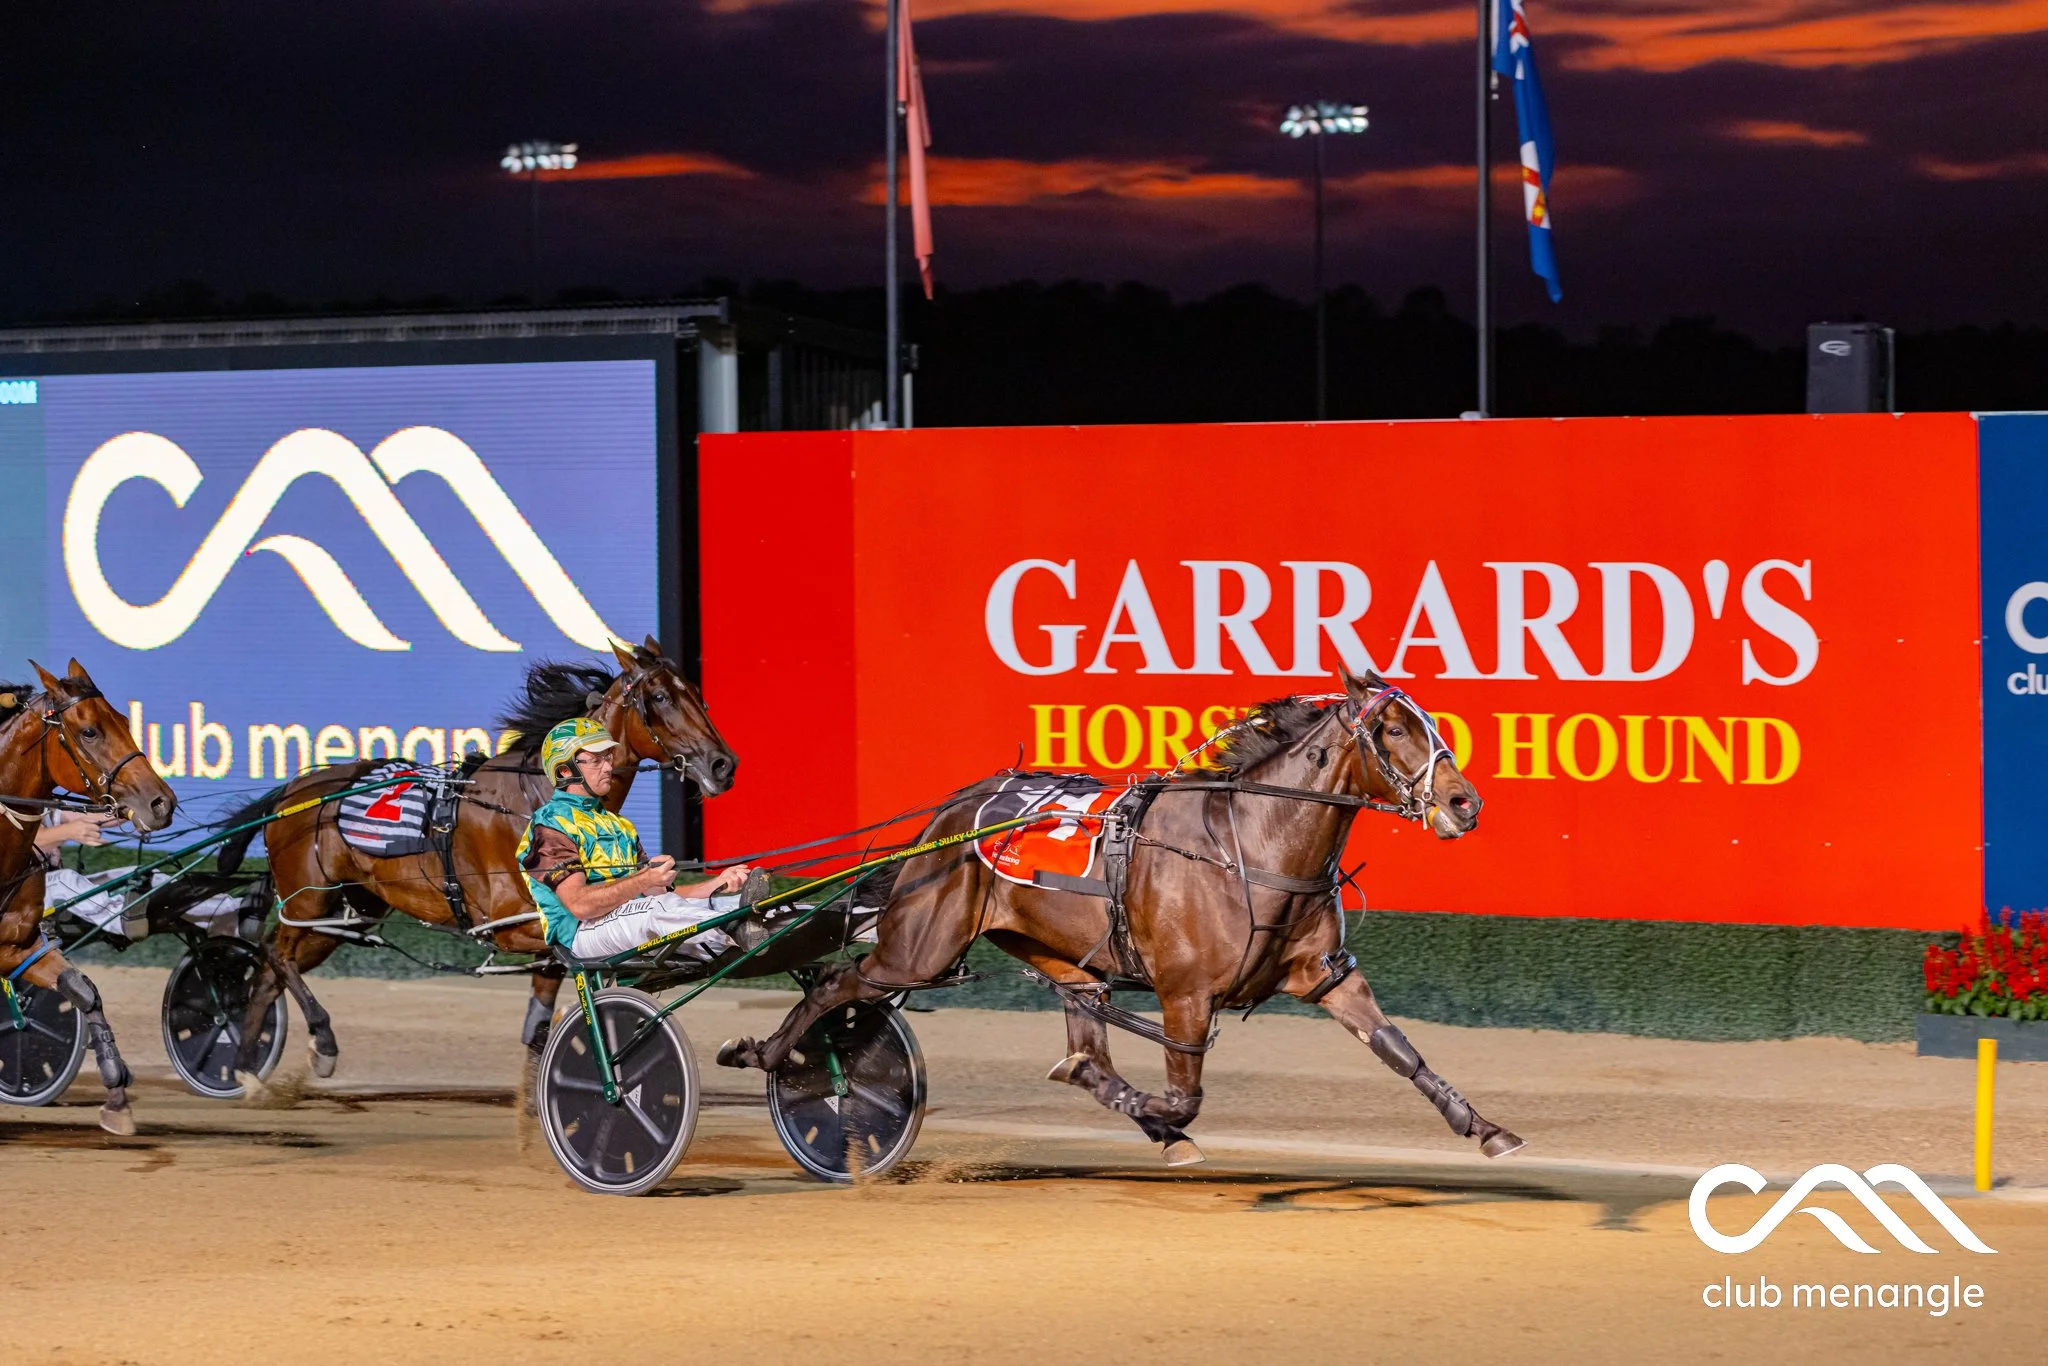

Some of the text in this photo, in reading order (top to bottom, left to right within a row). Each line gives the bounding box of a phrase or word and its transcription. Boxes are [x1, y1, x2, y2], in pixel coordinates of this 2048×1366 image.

[985, 558, 1820, 686] GARRARD'S
[129, 700, 234, 780] lub
[1029, 704, 1263, 771] HORS
[1492, 712, 1801, 785] HOUND
[666, 924, 698, 941] Racing
